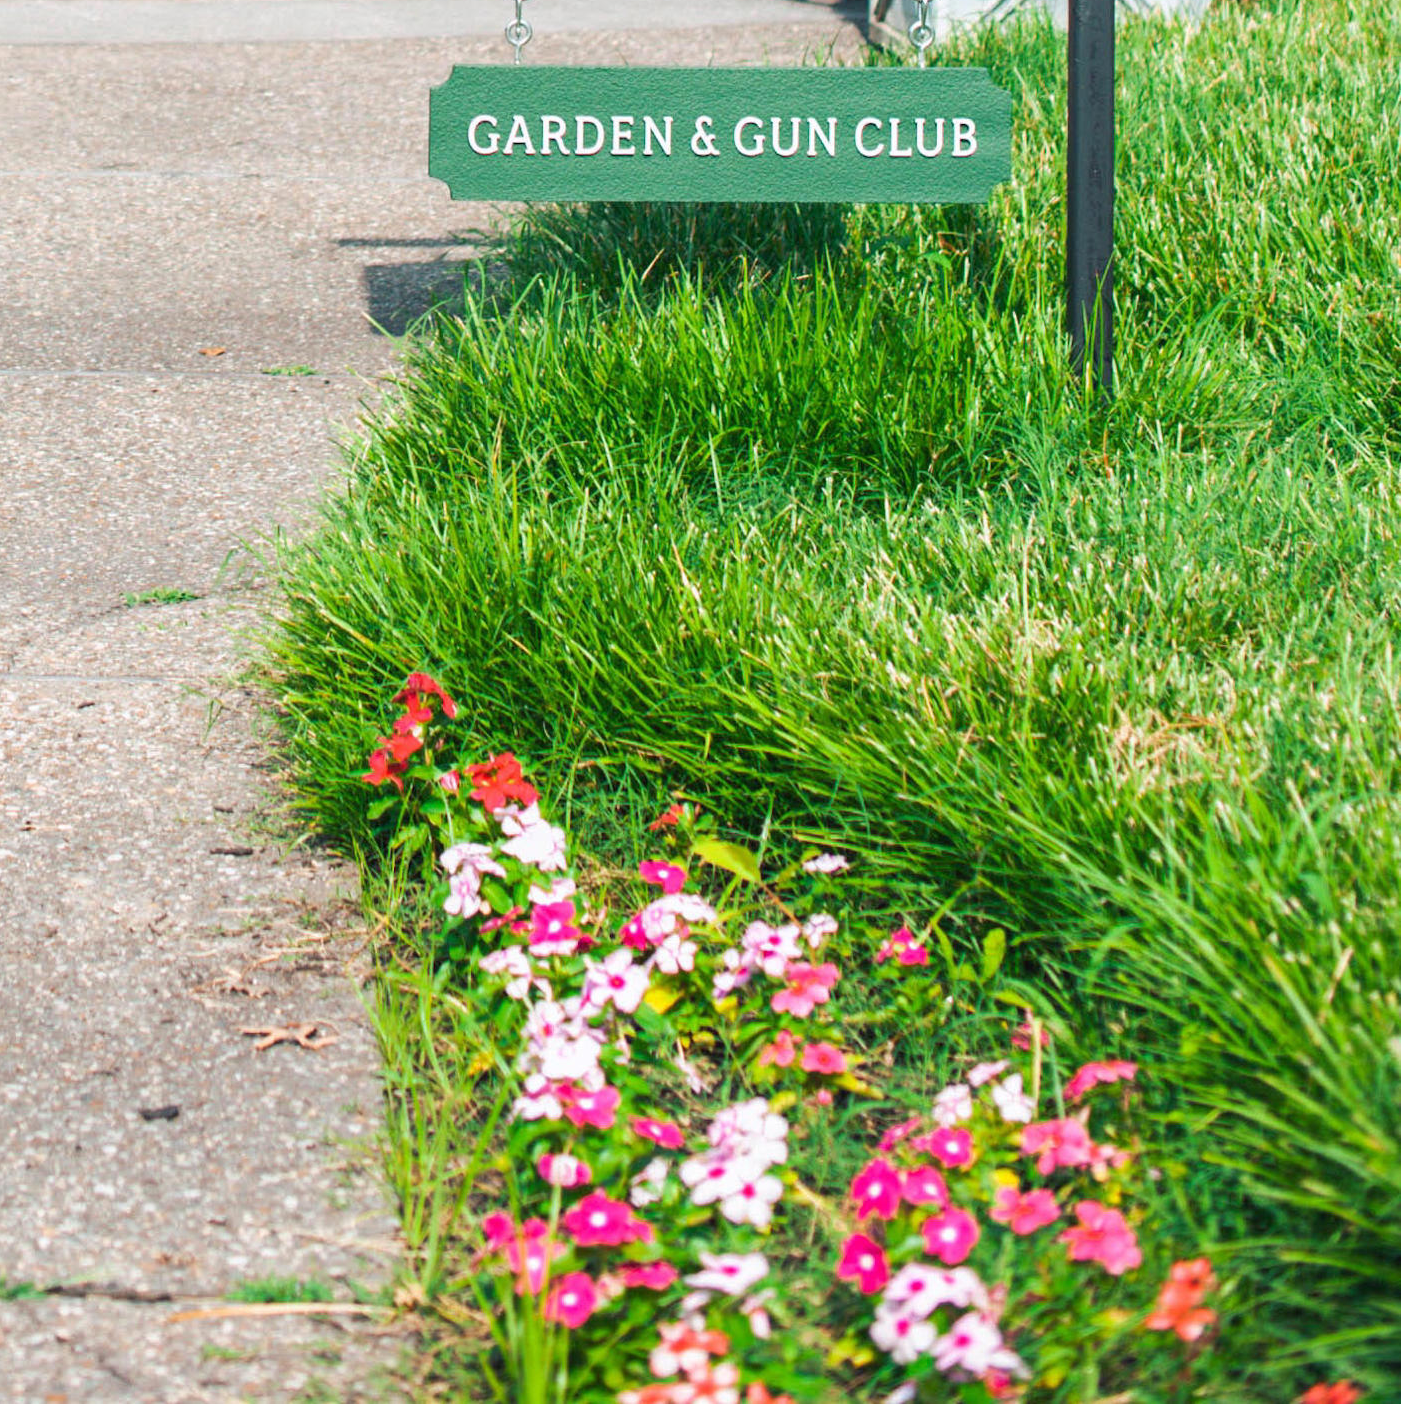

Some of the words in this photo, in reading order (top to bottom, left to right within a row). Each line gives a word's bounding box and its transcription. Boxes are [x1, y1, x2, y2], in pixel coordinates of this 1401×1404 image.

[466, 114, 675, 157] GARDEN
[690, 115, 722, 158] &
[733, 115, 838, 159] GUN
[854, 117, 979, 160] CLUB
